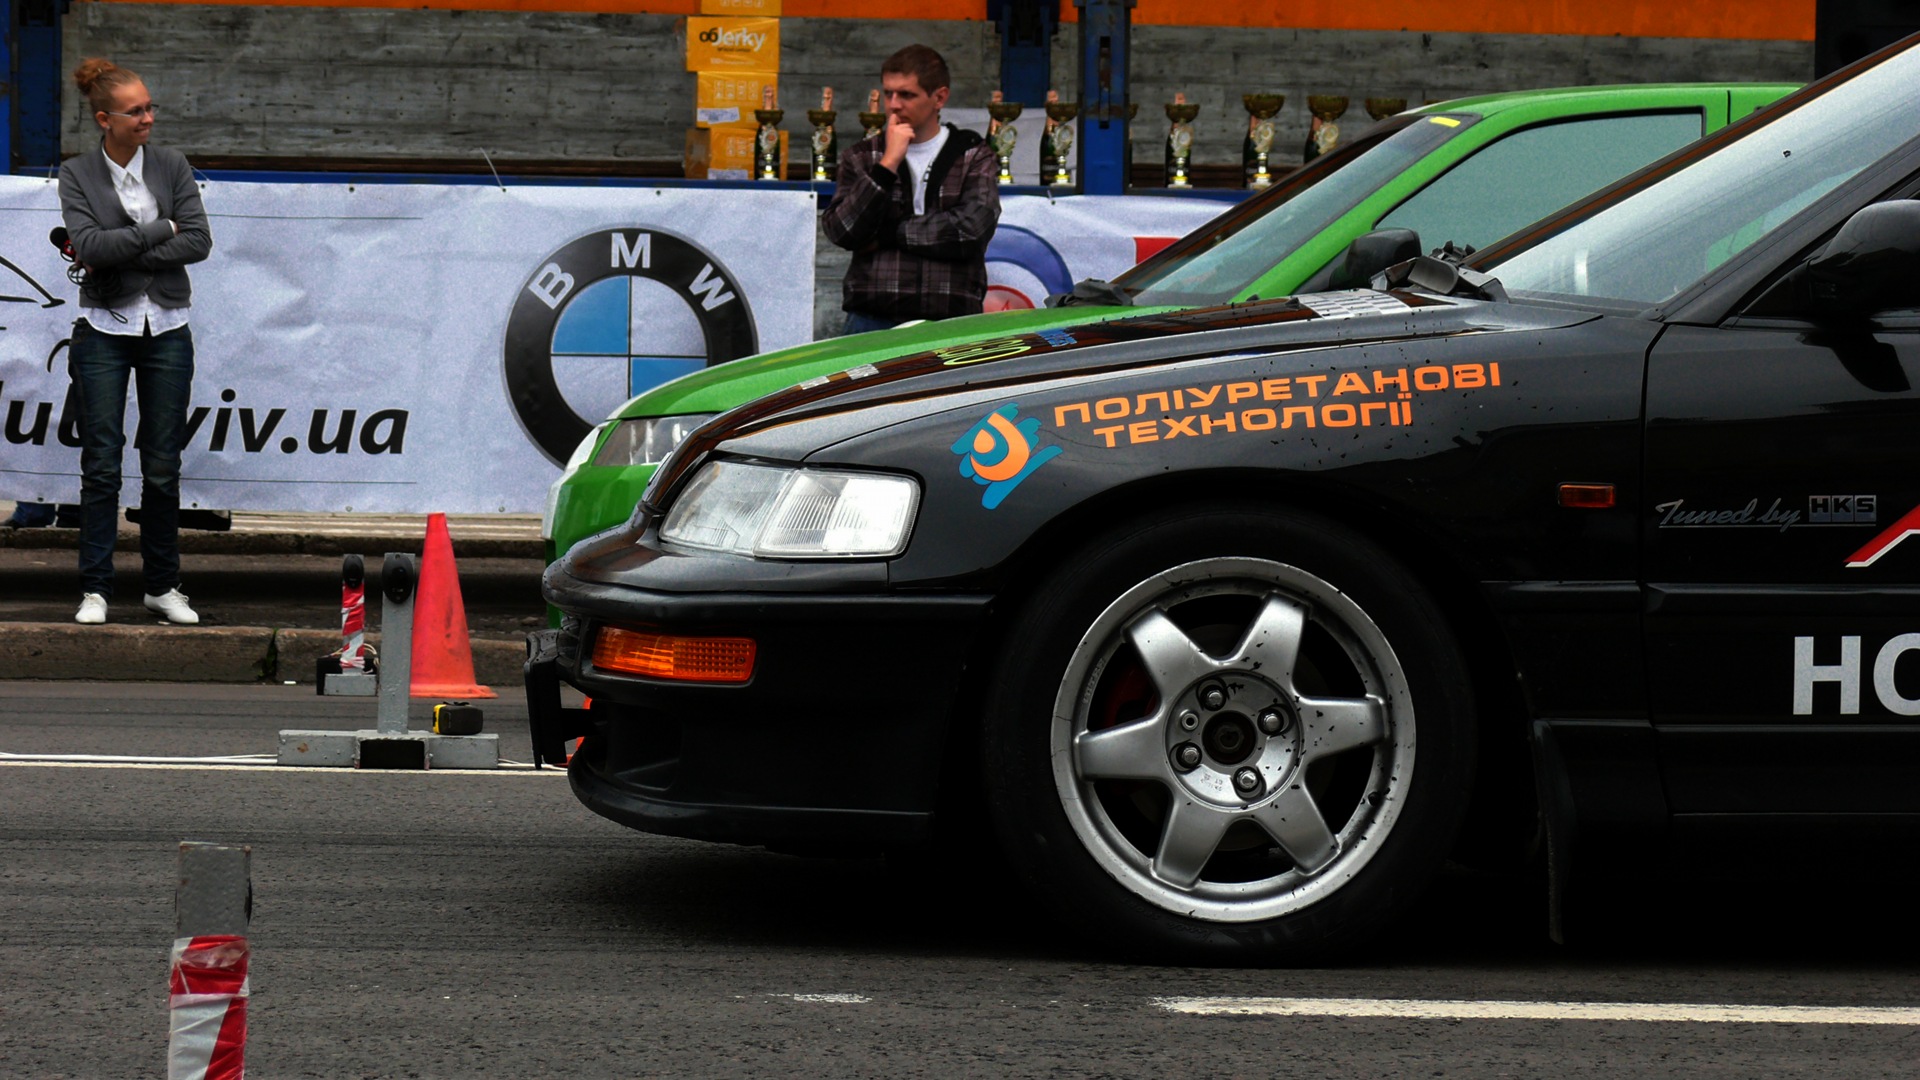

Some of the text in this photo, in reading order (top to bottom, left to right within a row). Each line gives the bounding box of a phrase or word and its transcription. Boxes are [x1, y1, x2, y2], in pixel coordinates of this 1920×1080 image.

[528, 232, 736, 312] BMW
[1053, 362, 1501, 428] ПОЛІУРЕТАНОВІ
[1093, 392, 1413, 449] ТЕХНОЛОГІЇ
[1654, 495, 1875, 533] Tuned by HKS
